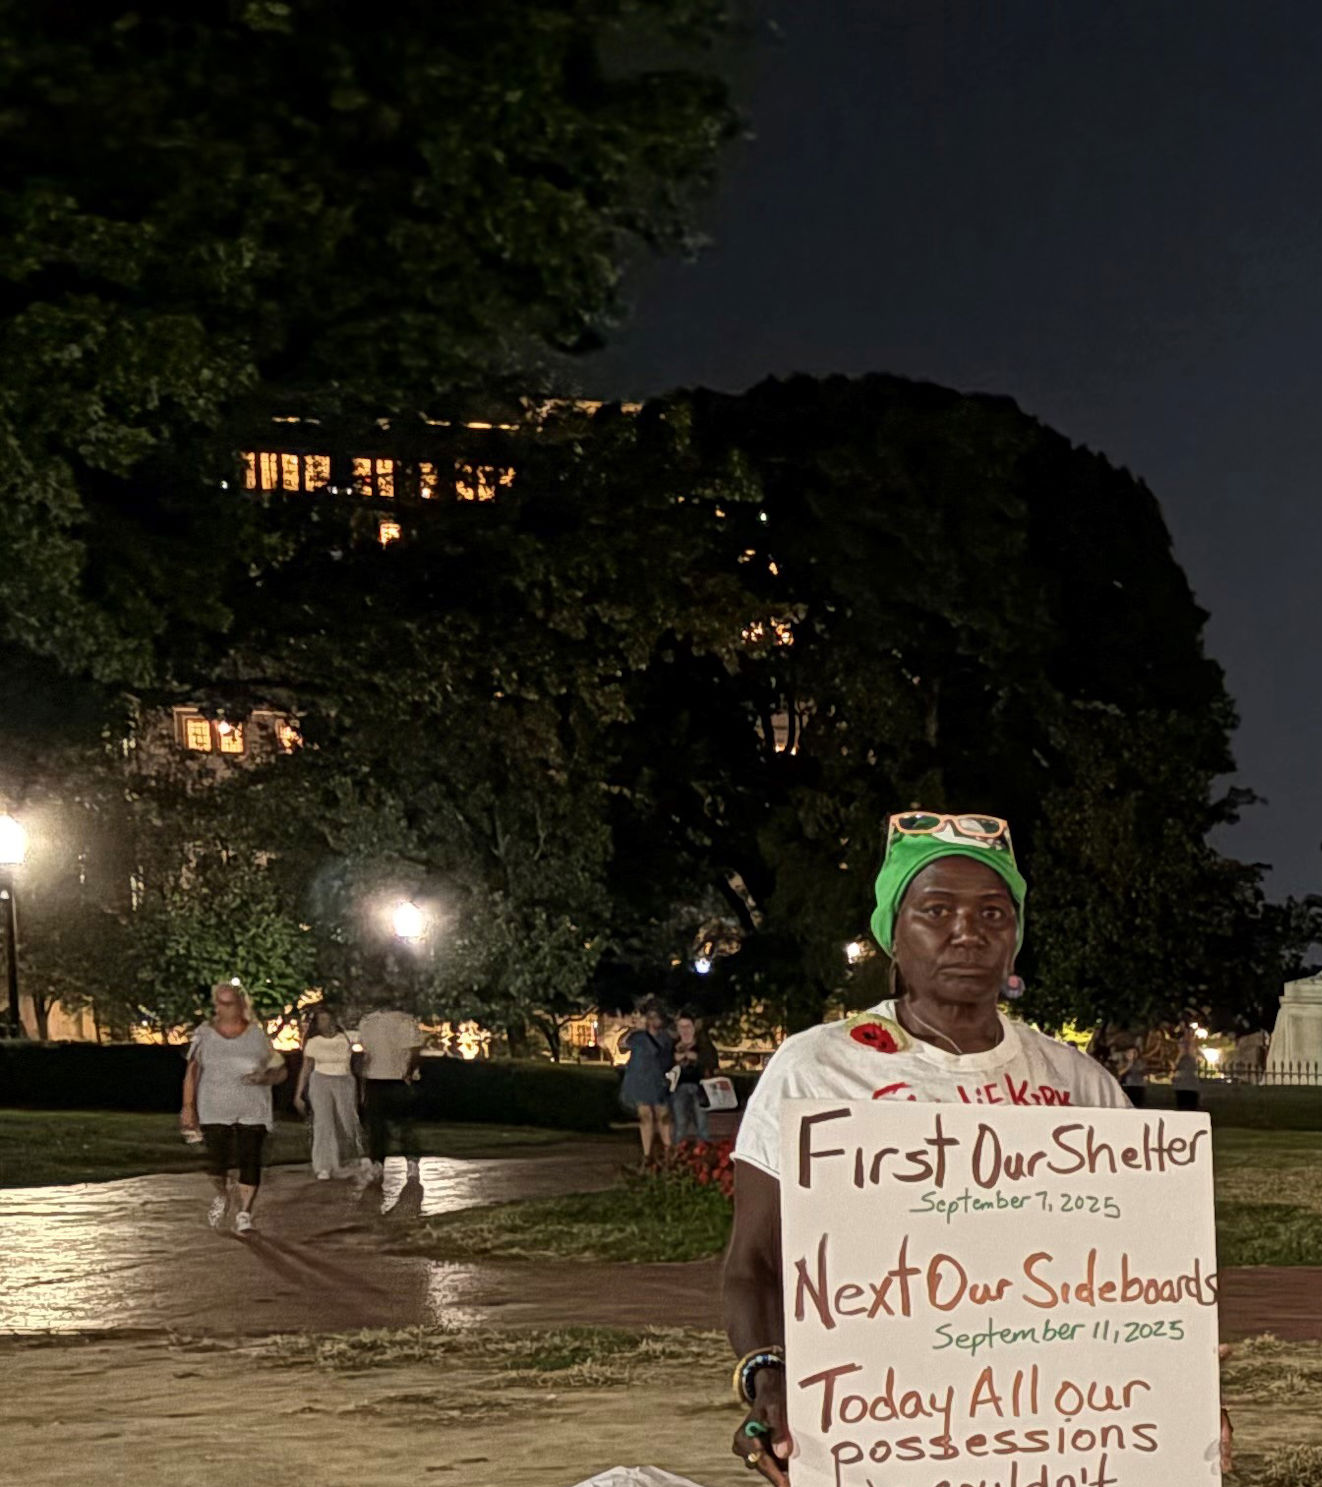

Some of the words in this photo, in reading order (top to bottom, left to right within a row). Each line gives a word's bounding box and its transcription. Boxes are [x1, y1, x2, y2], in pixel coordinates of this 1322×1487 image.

[798, 1108, 960, 1188] First
[972, 1124, 1052, 1188] Our
[1047, 1119, 1208, 1175] Shelter
[908, 1187, 1031, 1223] September
[1036, 1192, 1052, 1212] 7,
[1061, 1193, 1121, 1219] 2025
[794, 1234, 921, 1330] Next
[927, 1253, 1013, 1311] Our
[1022, 1249, 1218, 1308] Sideboards
[933, 1318, 1085, 1356] September
[1090, 1321, 1119, 1344] 11,
[1124, 1320, 1184, 1343] 2025
[798, 1363, 954, 1457] Today
[969, 1364, 1038, 1417] All
[1054, 1379, 1151, 1417] our
